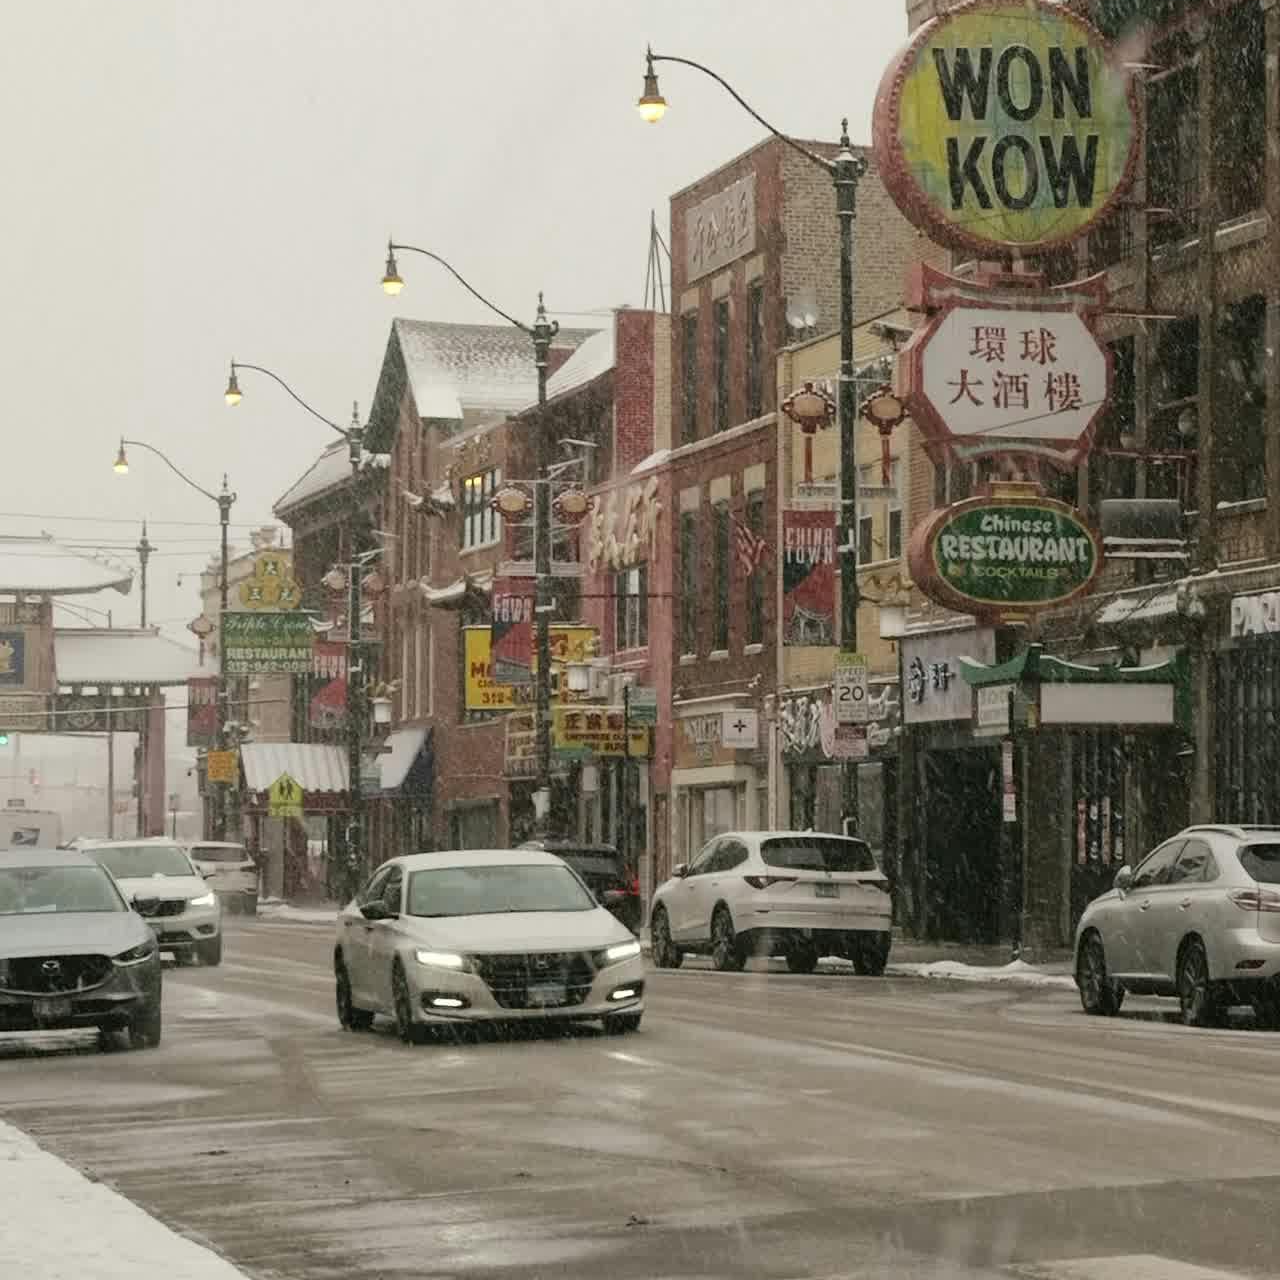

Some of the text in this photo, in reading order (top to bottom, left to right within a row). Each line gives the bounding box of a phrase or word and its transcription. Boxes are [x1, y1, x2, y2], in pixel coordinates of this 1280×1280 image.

[932, 46, 1092, 121] WON
[946, 135, 1099, 210] KOW
[969, 326, 1057, 365] 環球
[947, 369, 1082, 411] 大酒樓
[980, 514, 1053, 533] Chinese
[786, 527, 833, 545] CHINA
[786, 547, 833, 564] TOWN
[941, 535, 1089, 562] RESTAURANT
[975, 565, 1058, 578] COCKTAILS
[226, 648, 312, 659] RESTAURANT
[840, 686, 864, 701] 20
